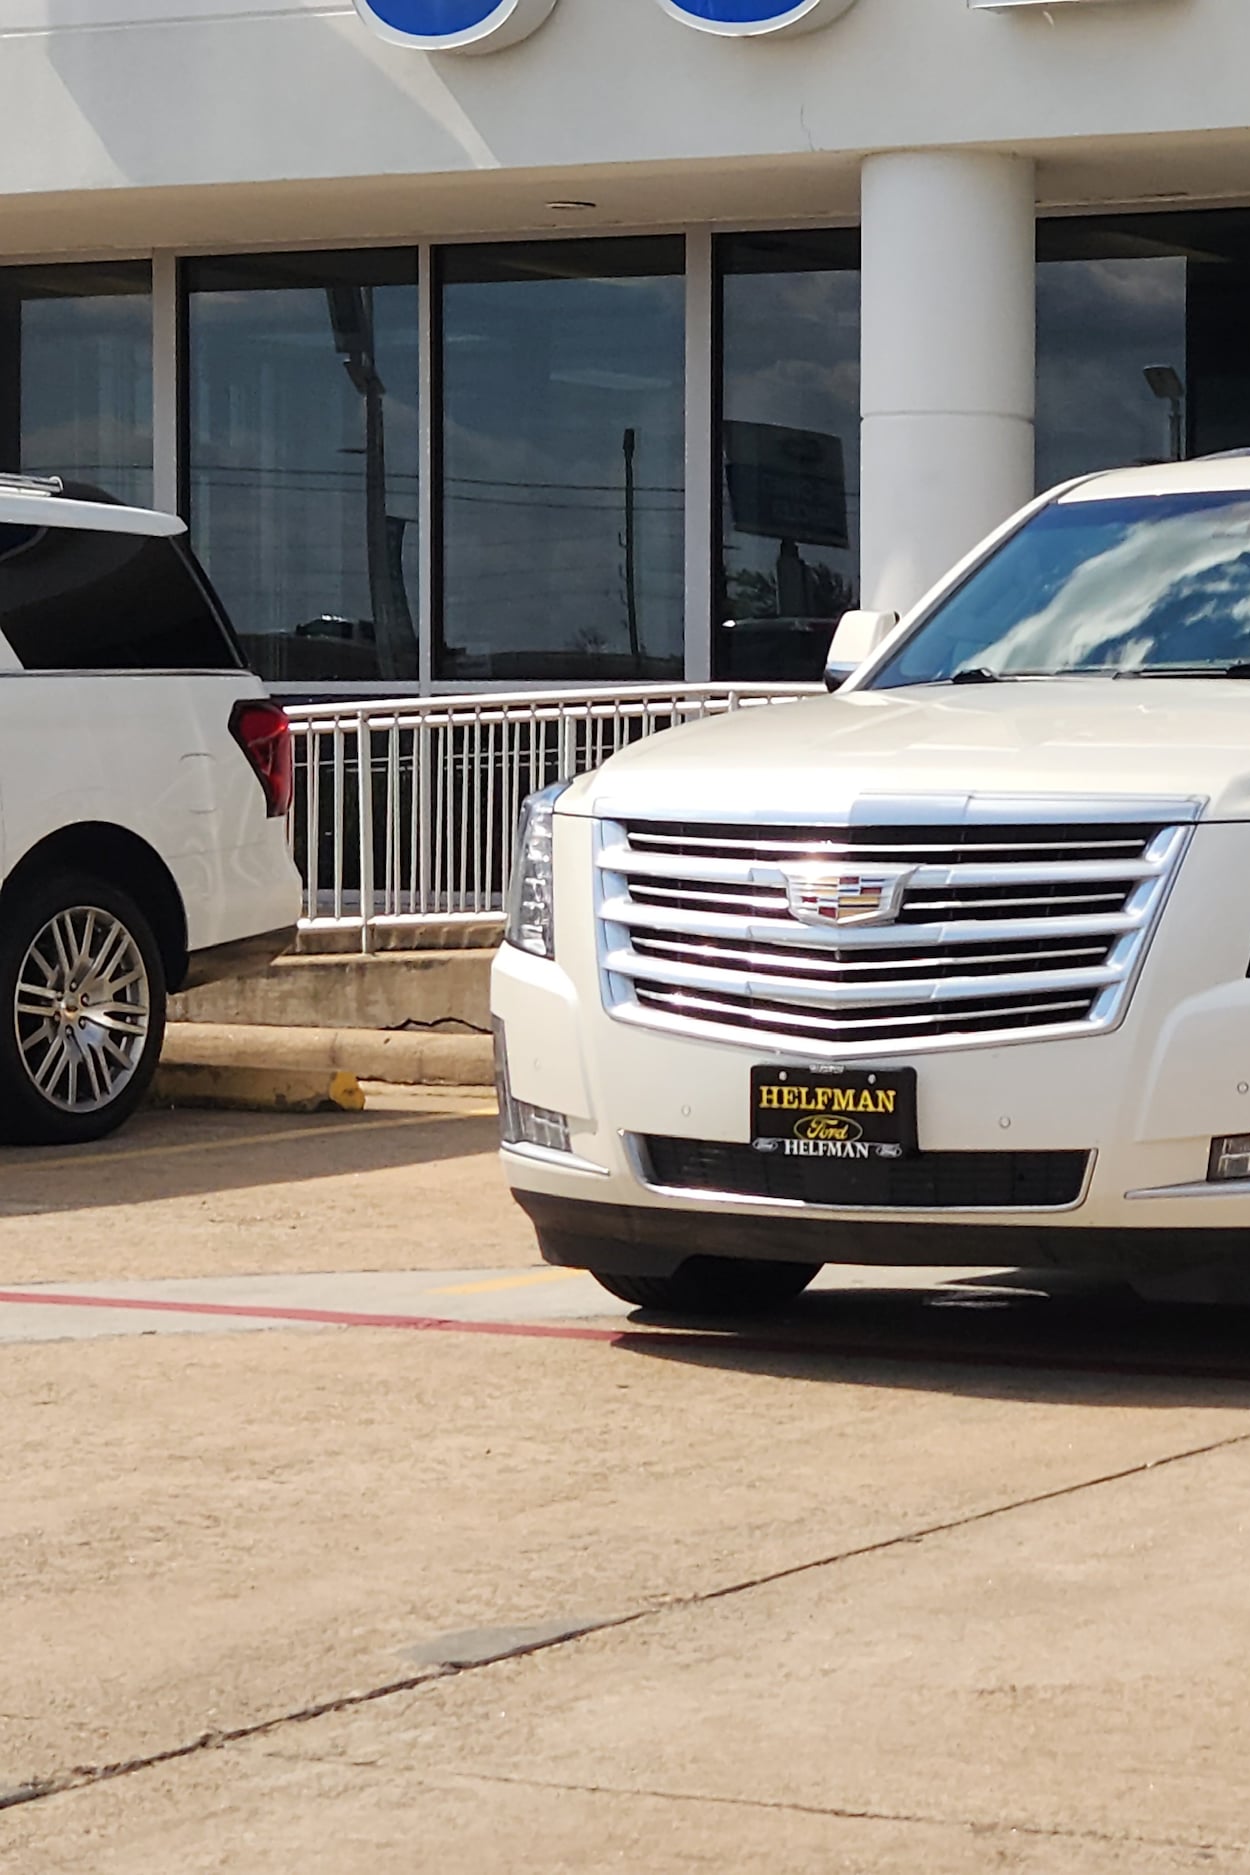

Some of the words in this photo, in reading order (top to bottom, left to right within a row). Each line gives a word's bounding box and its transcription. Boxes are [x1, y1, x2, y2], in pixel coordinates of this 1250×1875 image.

[759, 1085, 897, 1113] HELFMAN
[806, 1117, 849, 1140] Ford
[784, 1139, 870, 1159] HELFMAN
